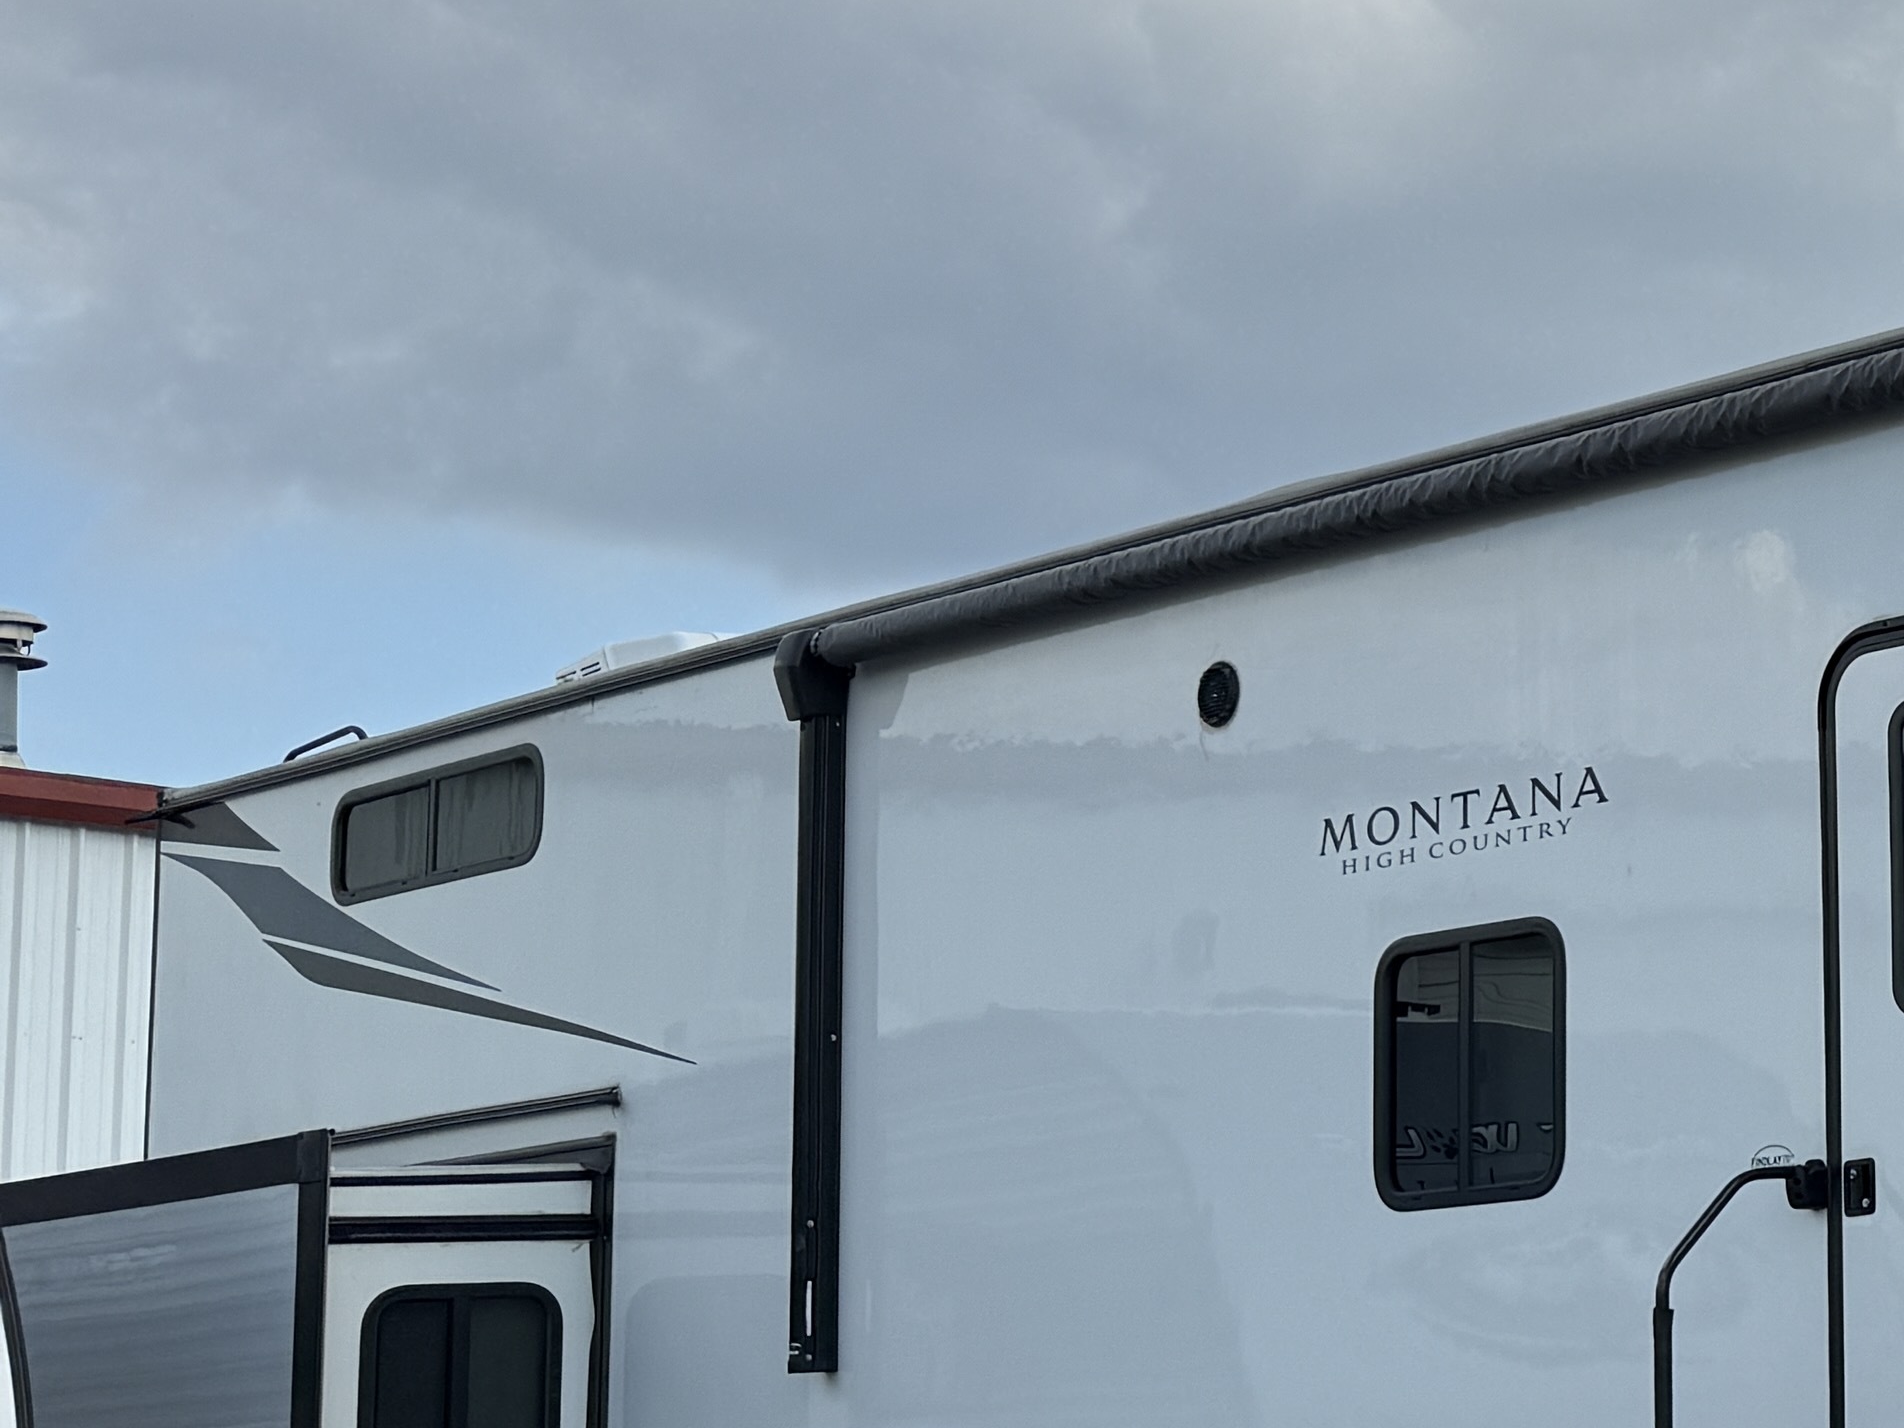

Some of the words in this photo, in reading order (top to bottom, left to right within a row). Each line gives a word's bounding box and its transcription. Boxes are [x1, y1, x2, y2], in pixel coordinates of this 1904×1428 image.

[1319, 766, 1610, 857] MONTANA
[1341, 846, 1416, 875] HIGH
[1429, 817, 1574, 860] COUNTRY
